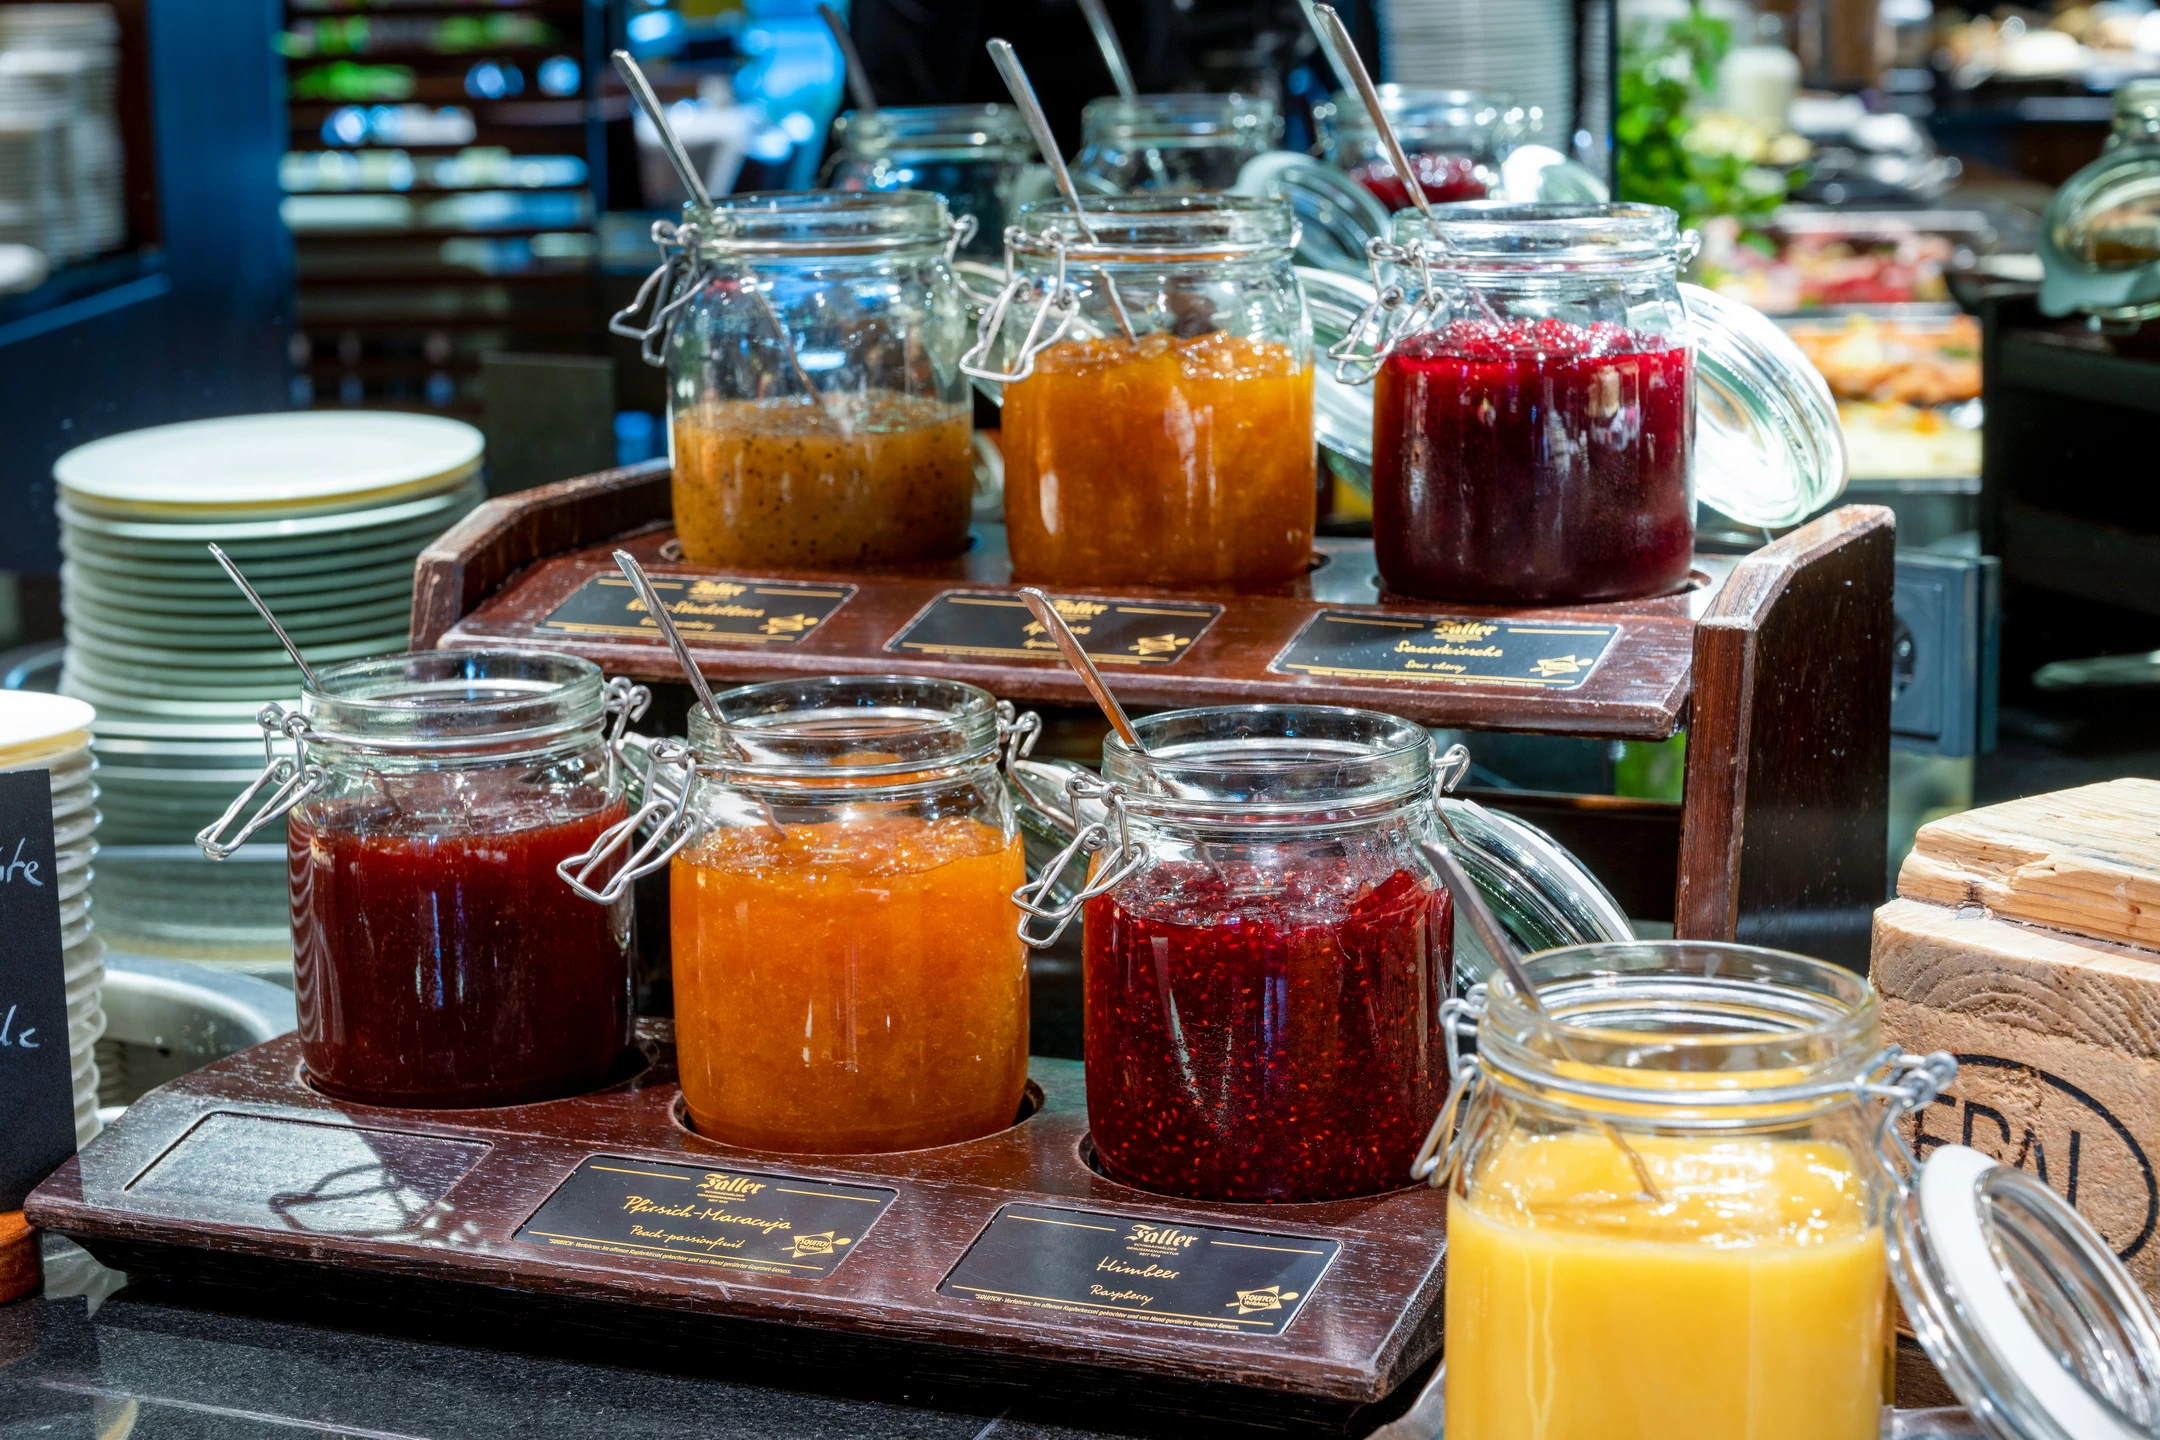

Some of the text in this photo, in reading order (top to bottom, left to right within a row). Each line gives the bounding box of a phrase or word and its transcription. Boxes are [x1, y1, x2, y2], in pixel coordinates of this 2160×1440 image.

[696, 1173, 767, 1195] Faller
[622, 1195, 792, 1235] Pfirsich-Maracuja
[629, 1225, 746, 1251] Peach-passionfruit
[1123, 1224, 1199, 1248] Faller
[1096, 1256, 1180, 1279] Himbeer
[1243, 1294, 1276, 1303] SQUITCH
